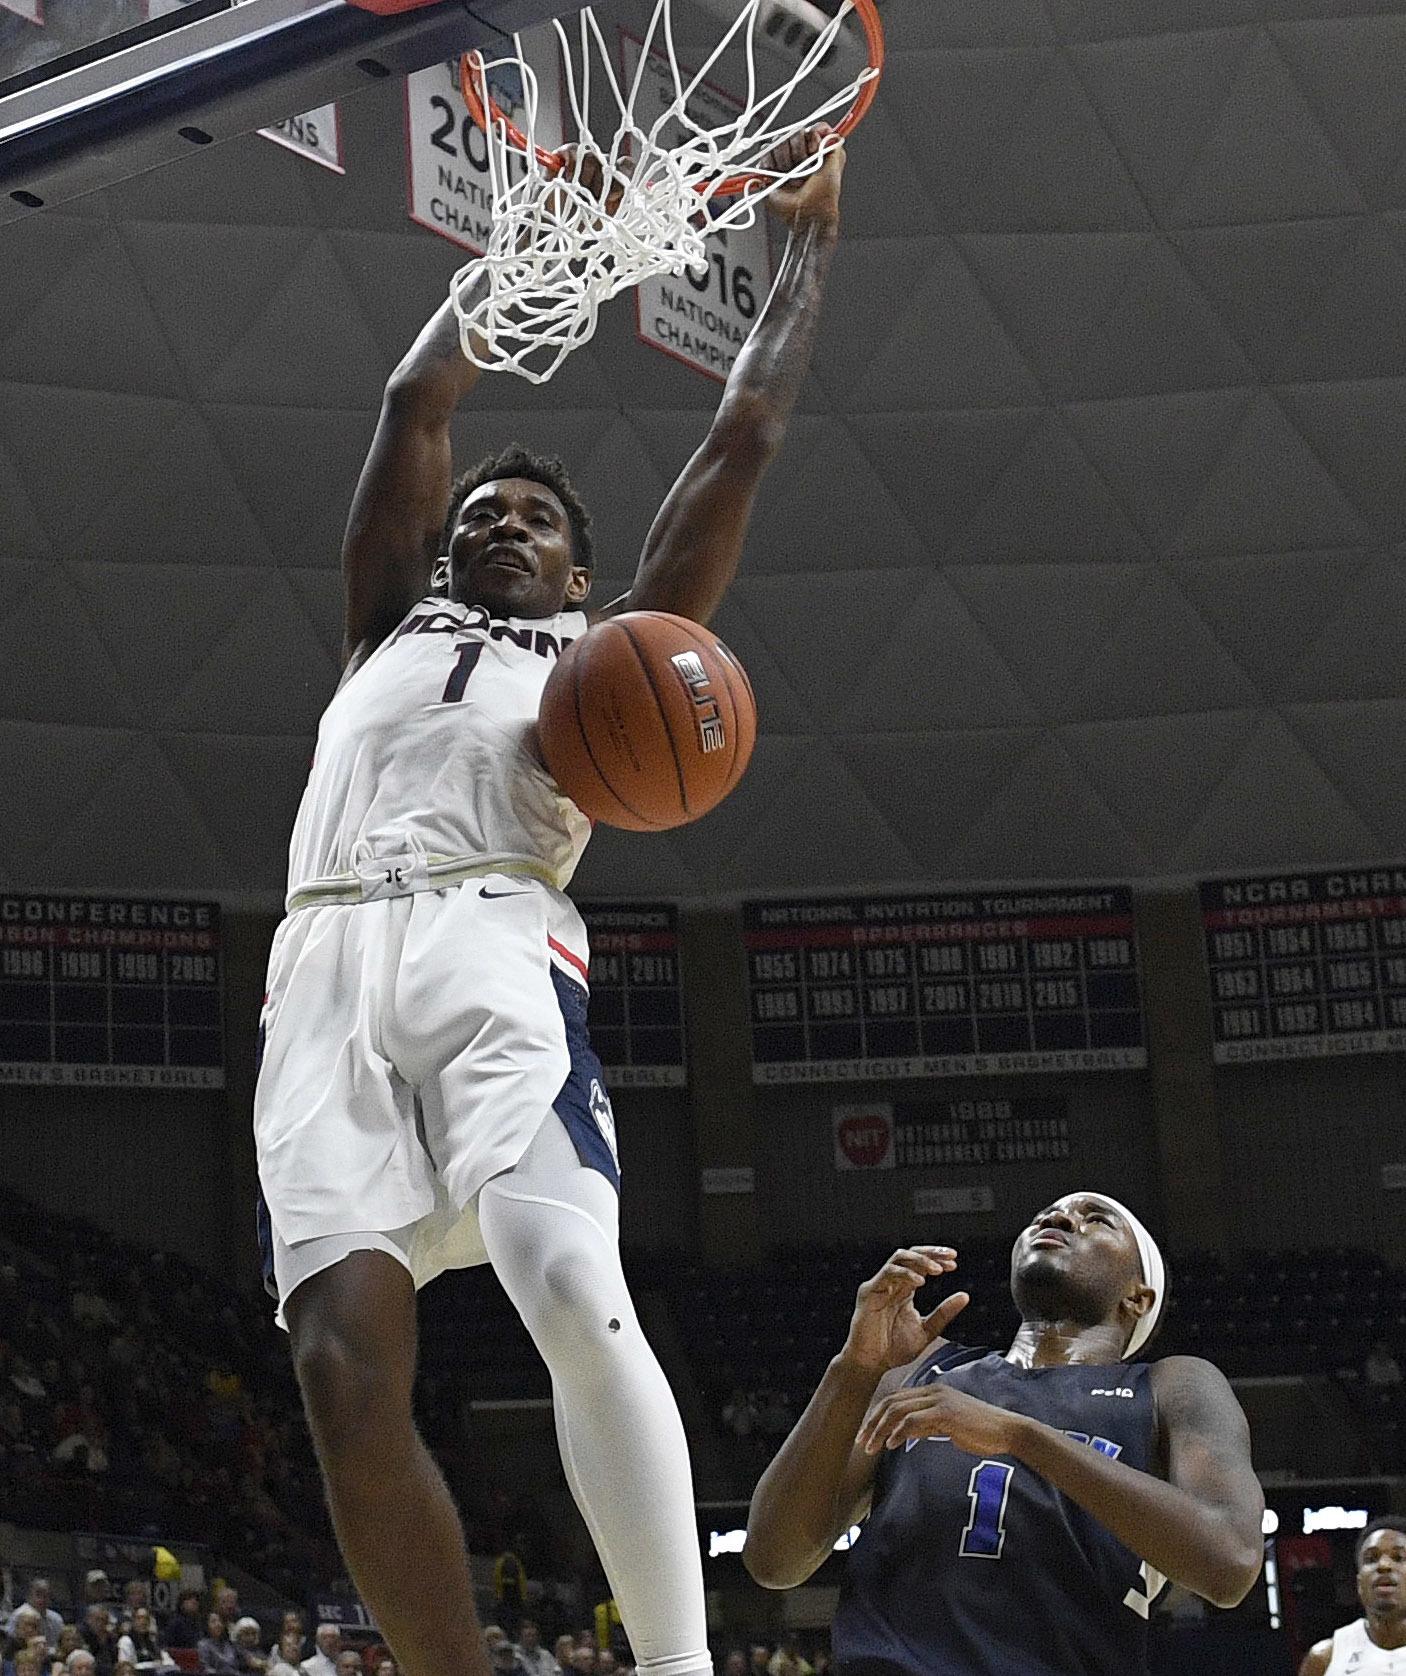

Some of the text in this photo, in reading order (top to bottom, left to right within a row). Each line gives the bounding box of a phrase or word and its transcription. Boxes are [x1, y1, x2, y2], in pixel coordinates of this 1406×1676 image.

[430, 95, 528, 188] 201
[671, 253, 756, 319] 016
[660, 286, 749, 346] NATIONA
[441, 642, 485, 702] 1
[1222, 879, 1310, 904] NCAA
[2, 900, 211, 927] CONFERENCE
[760, 894, 1113, 923] NATIONAL INVITATION TOURNAMENT
[68, 928, 212, 949] CHAMPIONS
[853, 920, 1028, 942] APPEARANCES
[73, 1069, 213, 1086] BASKETBALL
[766, 1062, 911, 1080] CONNECTICUT
[998, 1052, 1134, 1070] BASKETBALL
[845, 1128, 885, 1148] NIT
[959, 1459, 1014, 1559] 1
